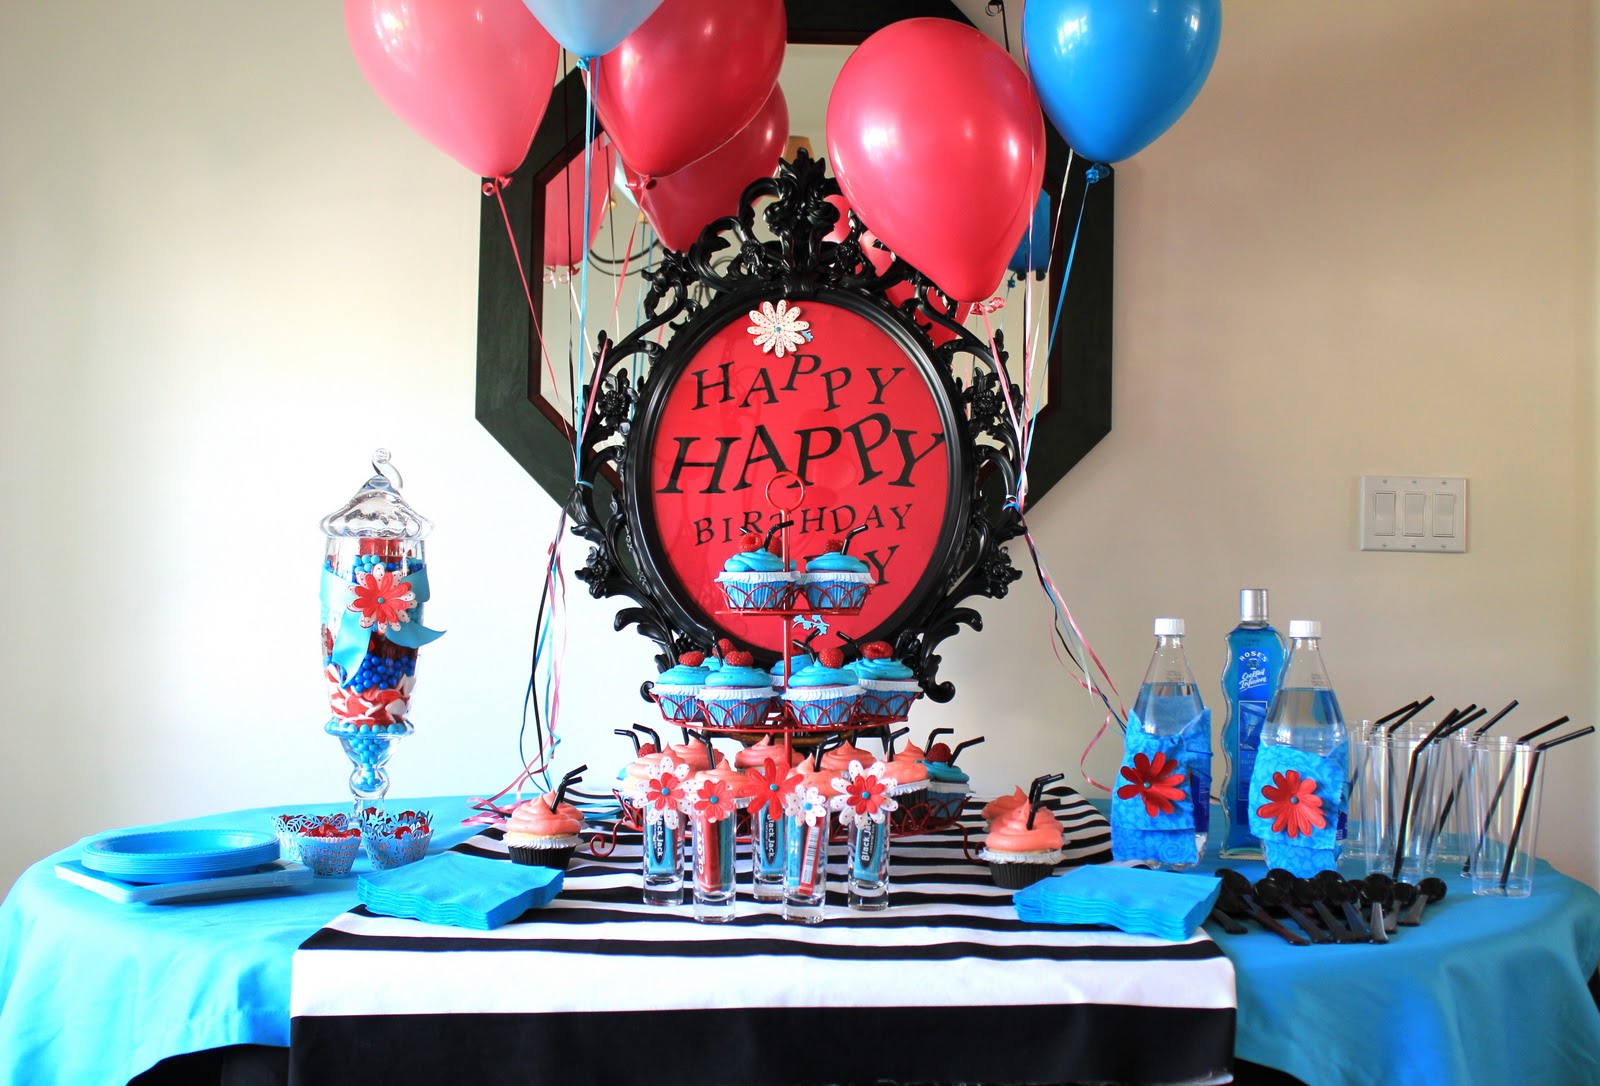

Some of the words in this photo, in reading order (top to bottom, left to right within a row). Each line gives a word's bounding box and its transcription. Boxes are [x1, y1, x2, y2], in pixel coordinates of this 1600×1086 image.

[691, 353, 905, 412] HAPPY
[656, 412, 945, 494] HAPPY
[861, 836, 870, 861] Black
